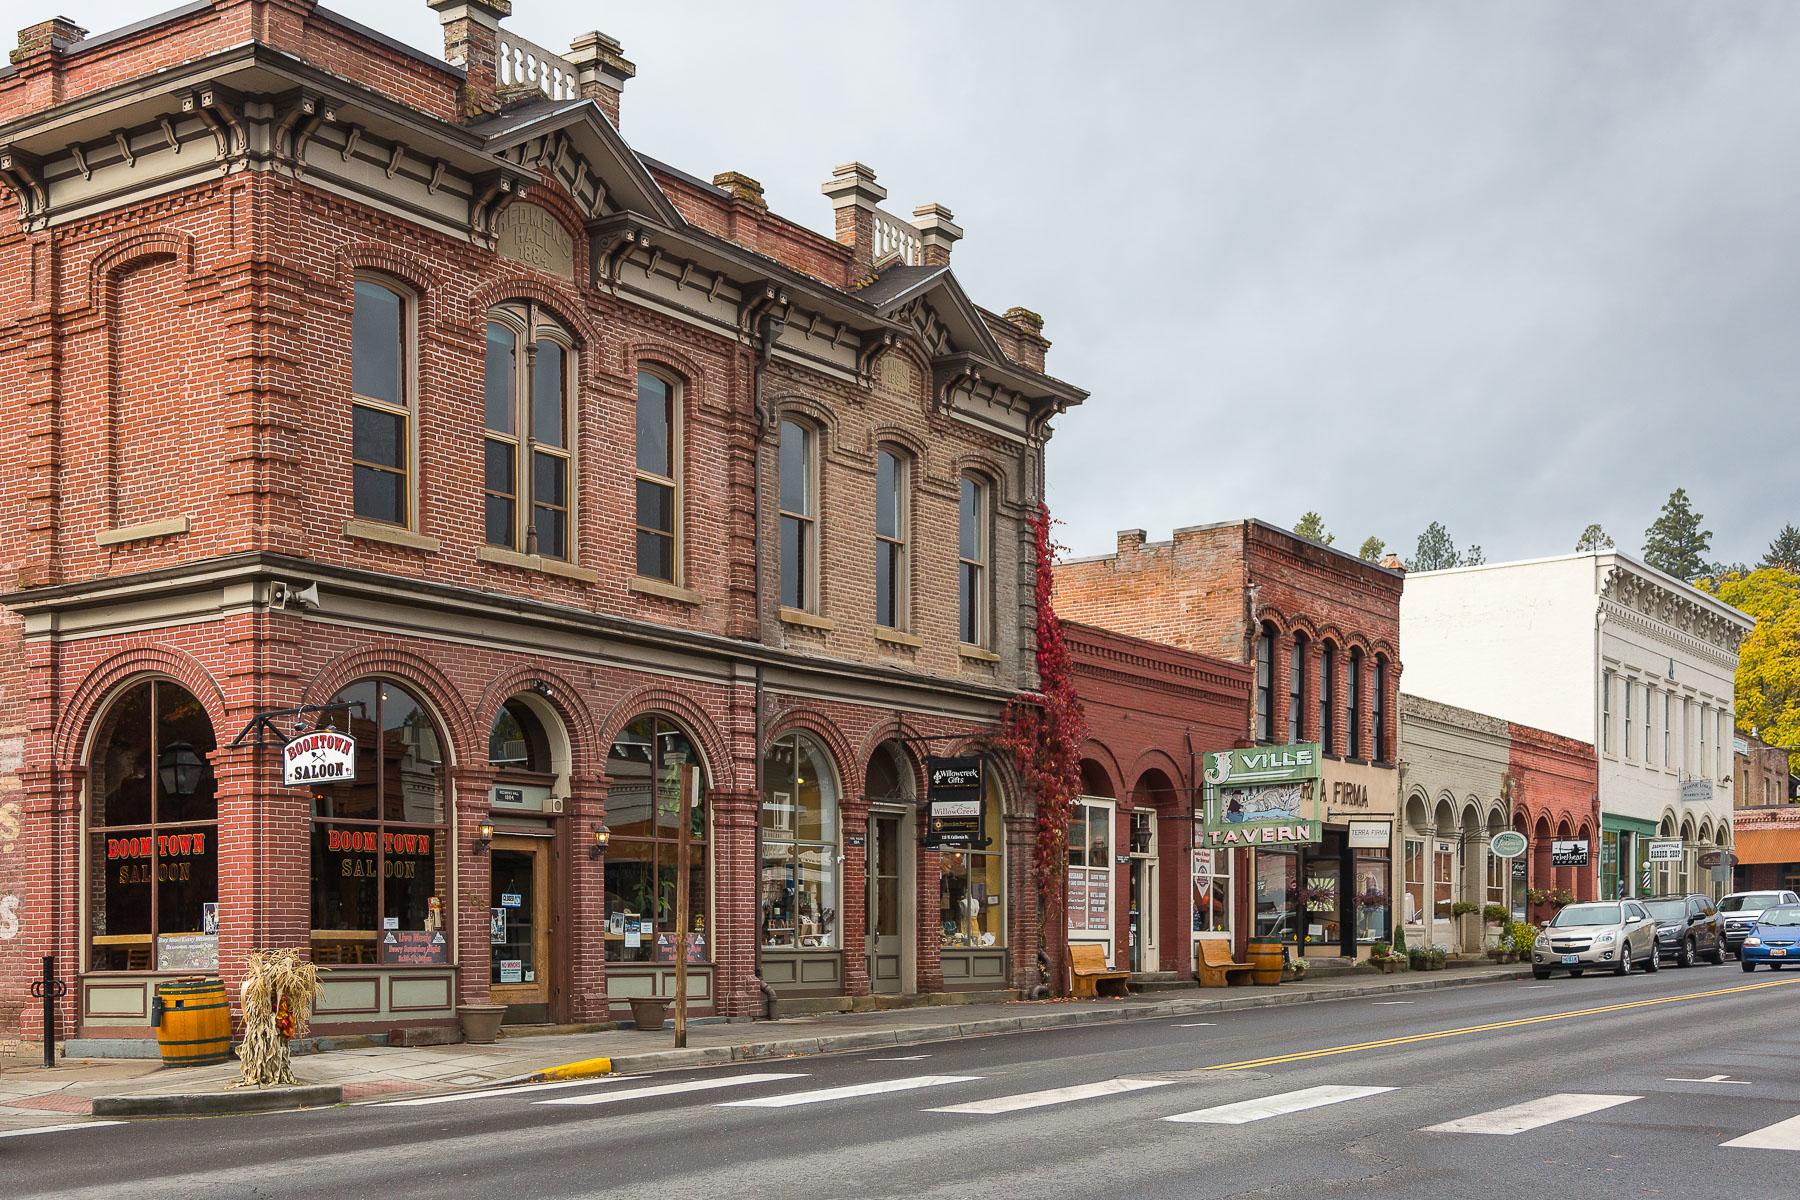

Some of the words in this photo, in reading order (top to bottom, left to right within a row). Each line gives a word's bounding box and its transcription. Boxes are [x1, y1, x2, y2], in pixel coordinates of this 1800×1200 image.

[514, 224, 554, 259] HALL
[286, 734, 353, 761] BOOMTOWN
[294, 761, 345, 781] SALOON
[940, 769, 979, 778] Willowcreek
[1204, 751, 1234, 785] J
[1240, 750, 1313, 769] VILLE
[1333, 781, 1369, 808] FIRMA
[1208, 825, 1311, 846] TAVERN
[1371, 829, 1389, 837] FIRMA
[1650, 850, 1668, 859] BARBER
[1669, 850, 1680, 858] SHOP
